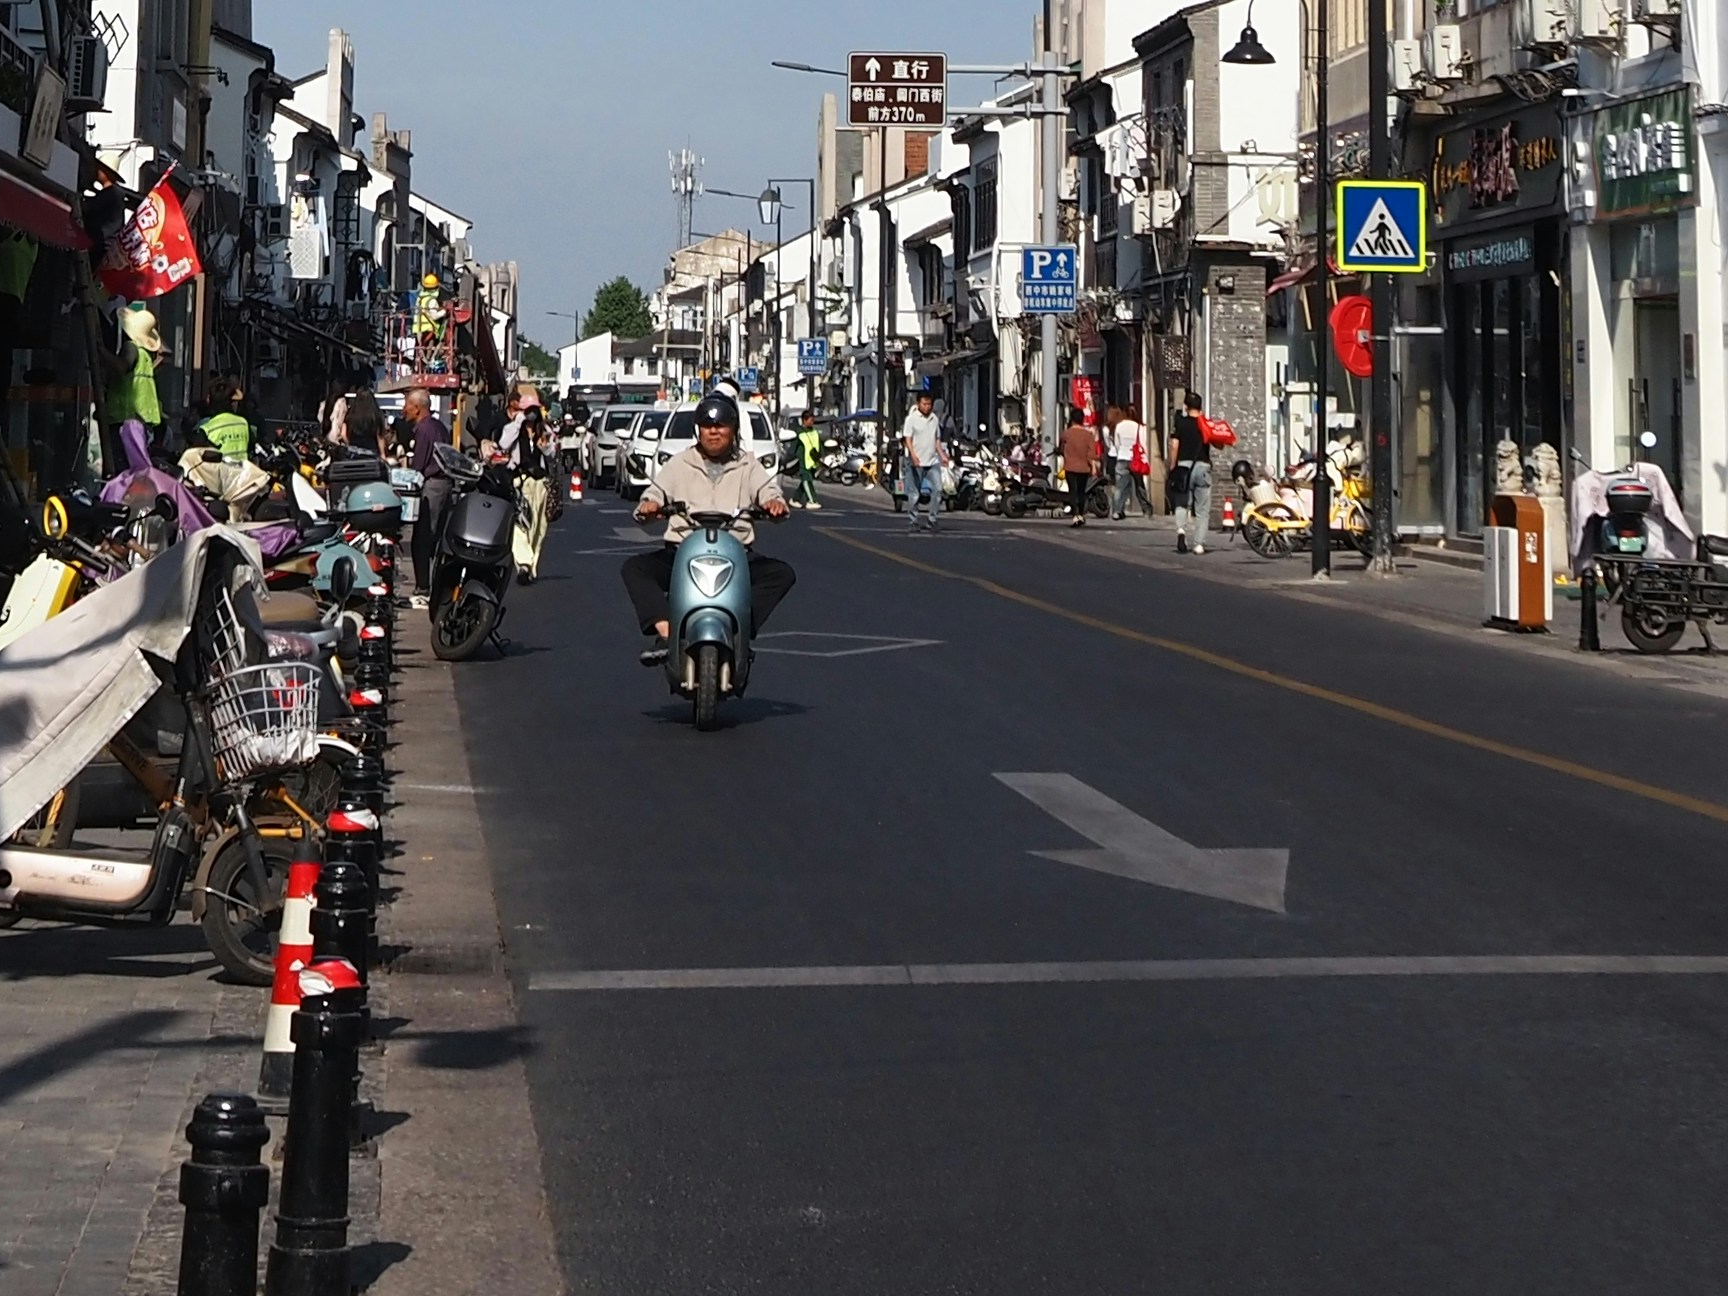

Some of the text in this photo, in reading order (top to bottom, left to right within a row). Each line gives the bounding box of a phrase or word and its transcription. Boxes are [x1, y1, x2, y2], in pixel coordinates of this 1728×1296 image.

[891, 59, 930, 80] 直行
[867, 105, 926, 122] 前方370m
[1030, 251, 1052, 279] P
[802, 341, 814, 356] P
